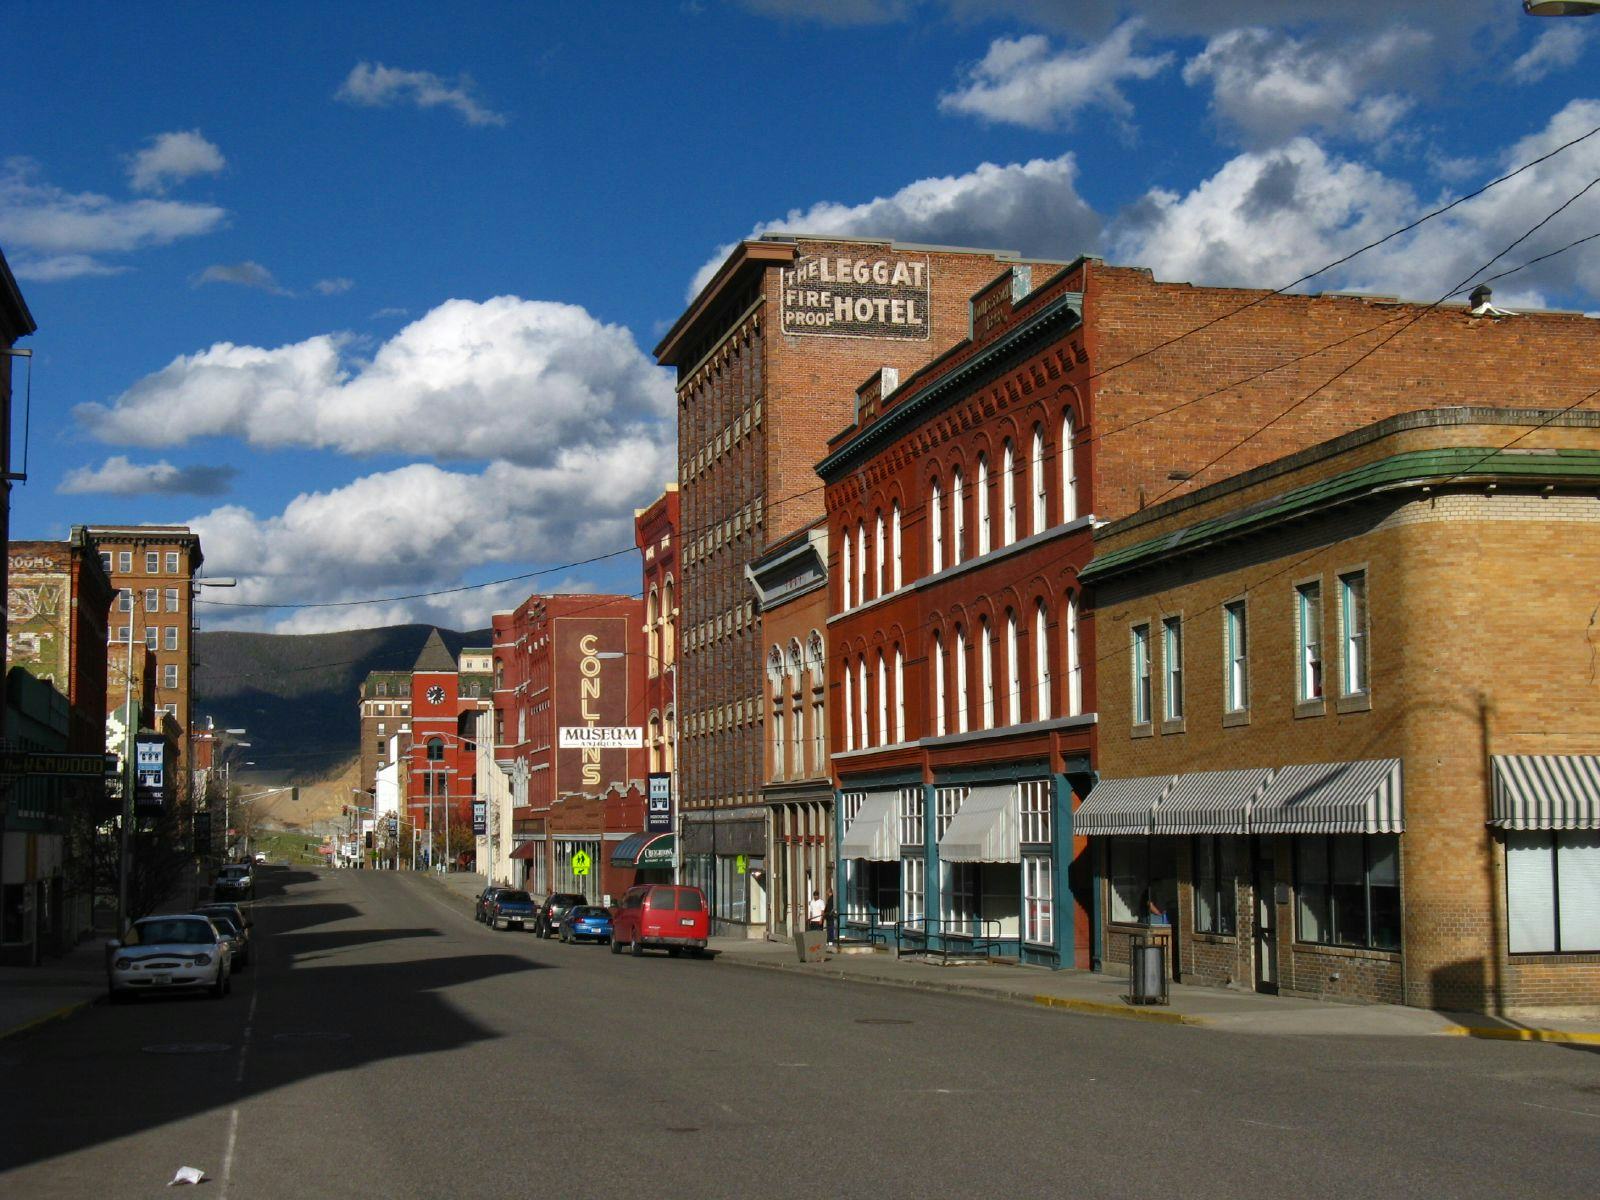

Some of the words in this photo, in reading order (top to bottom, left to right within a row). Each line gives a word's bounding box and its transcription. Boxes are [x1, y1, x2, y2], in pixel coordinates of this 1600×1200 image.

[785, 260, 819, 287] THE
[820, 257, 925, 287] LEGGAT
[786, 289, 831, 307] FIRE
[785, 311, 834, 326] PROOF
[834, 296, 922, 325] HOTEL
[565, 728, 637, 741] MUSEUM
